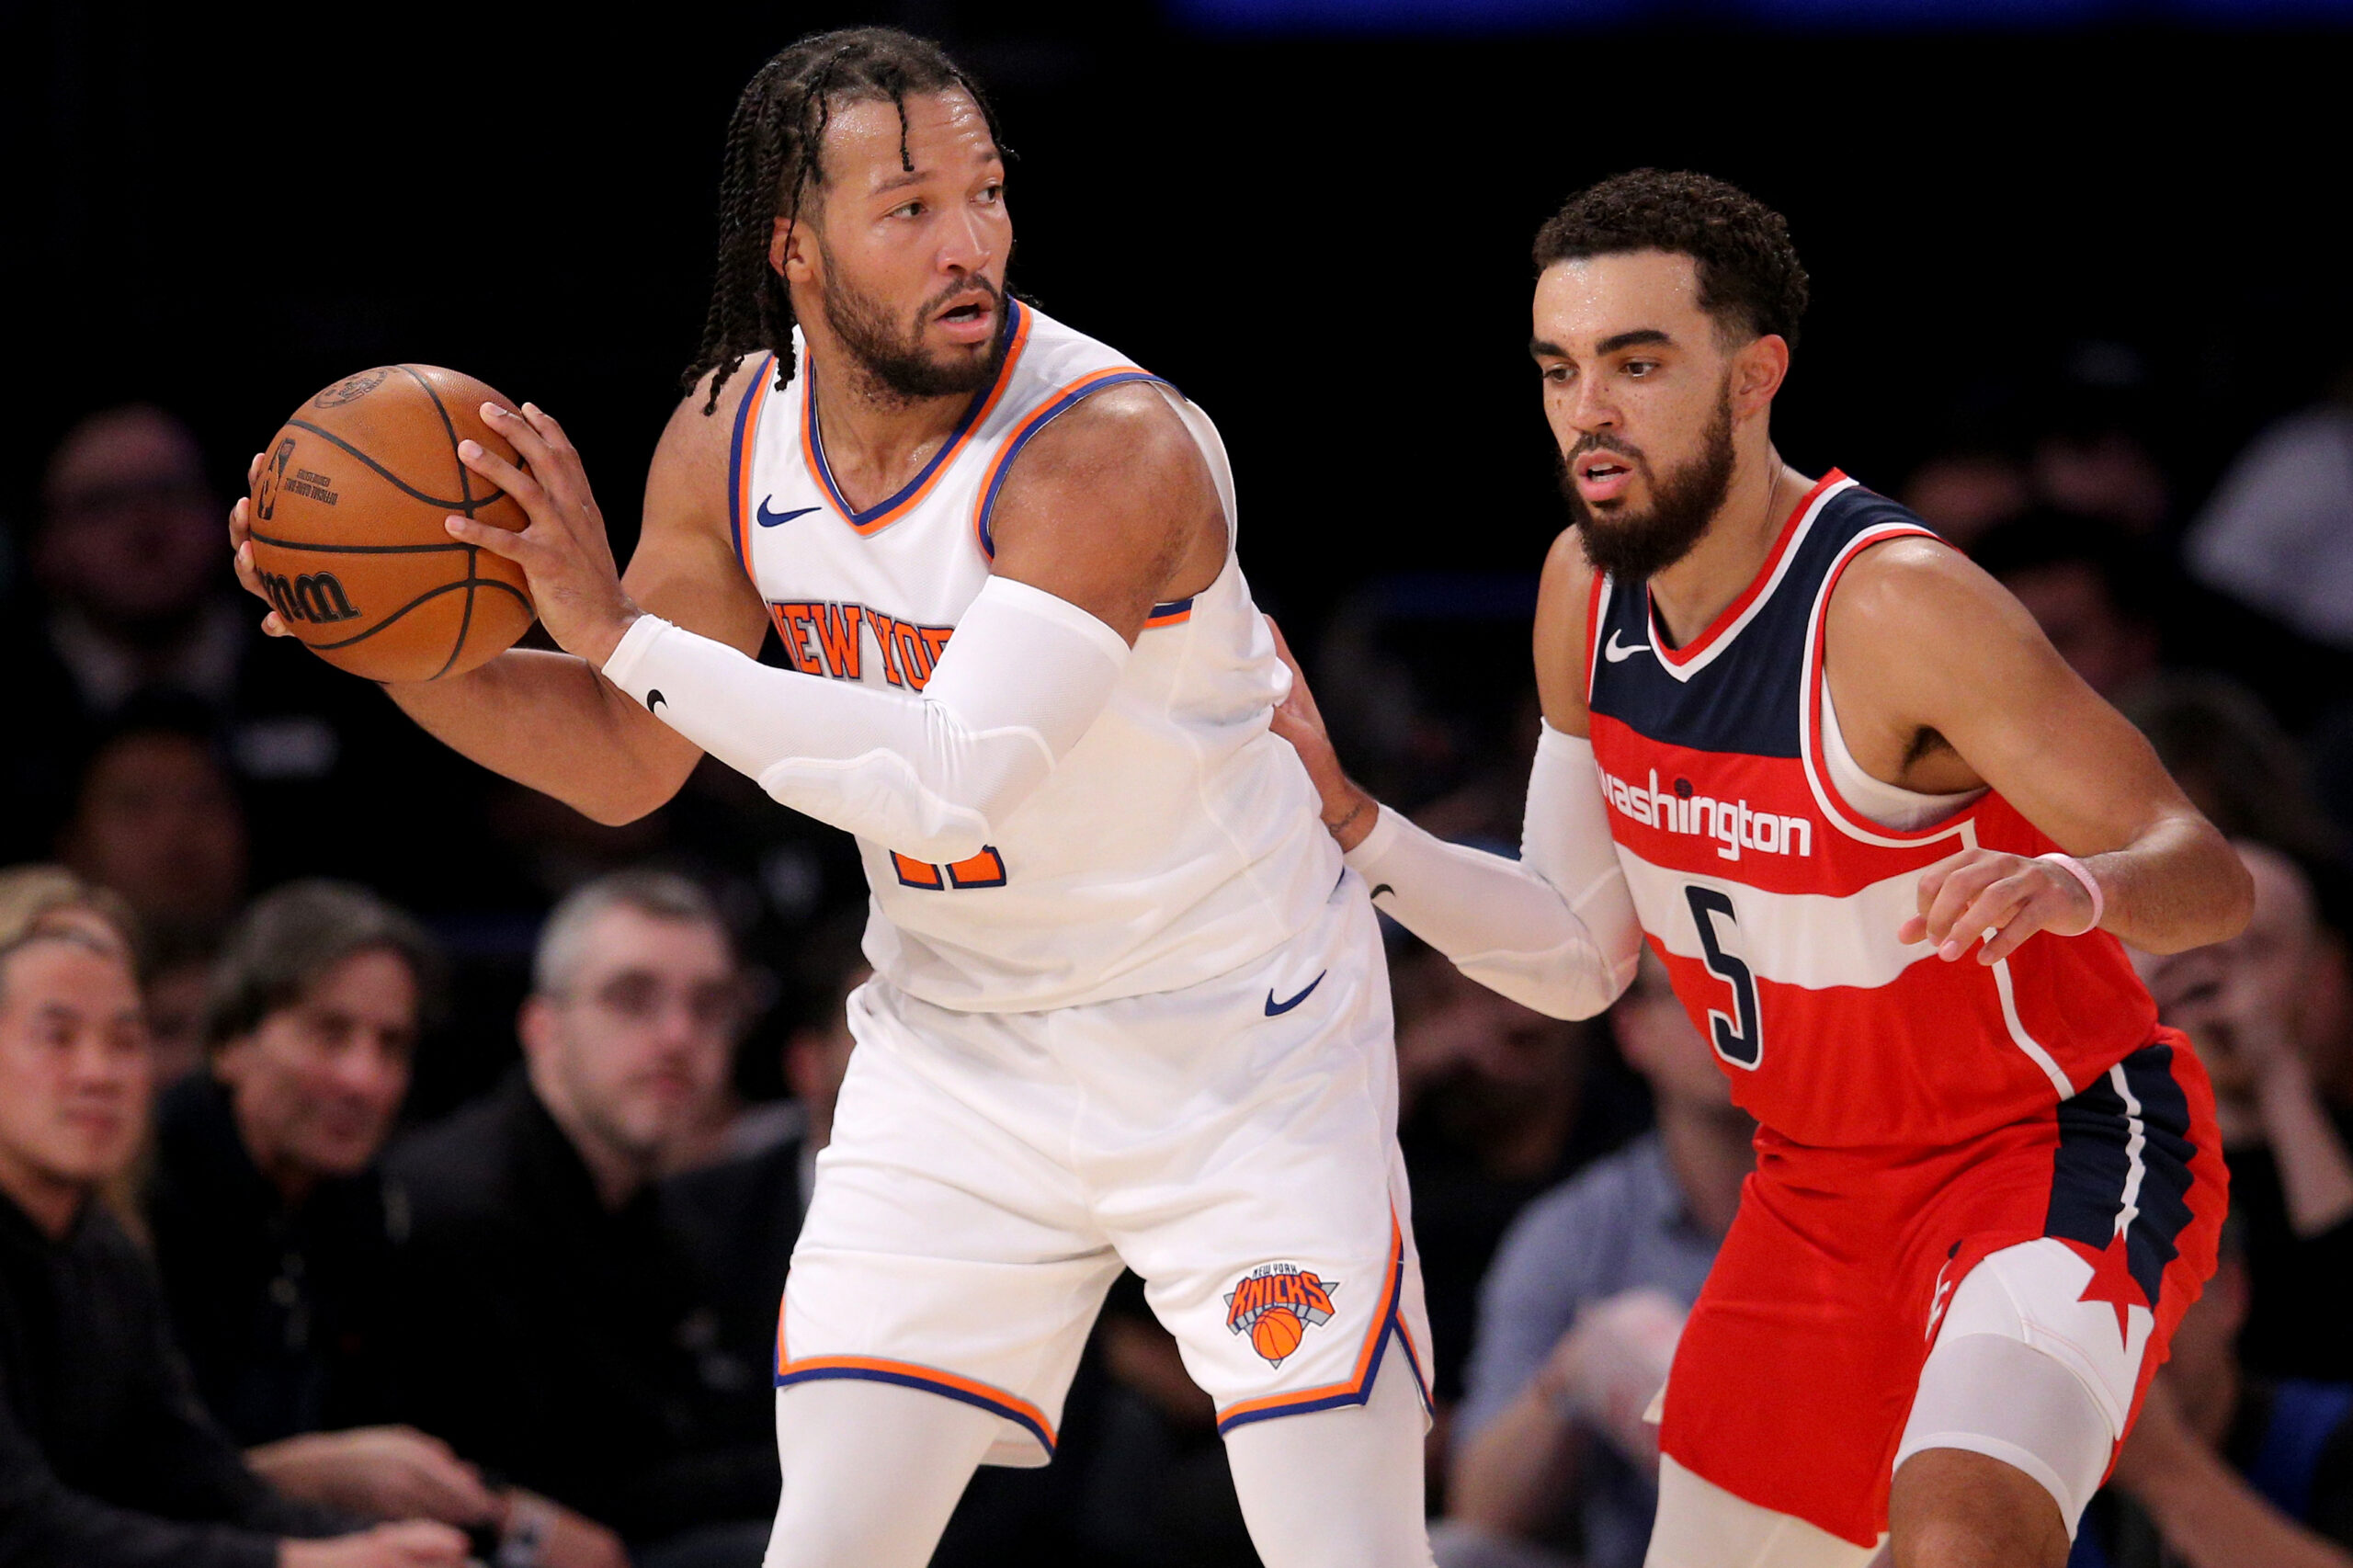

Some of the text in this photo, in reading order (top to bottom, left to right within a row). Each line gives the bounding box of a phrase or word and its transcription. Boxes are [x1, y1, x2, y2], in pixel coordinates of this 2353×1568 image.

[1685, 884, 1763, 1072] 5
[1226, 1270, 1336, 1325] KNICKS
[1253, 1263, 1298, 1278] NEW YORK
